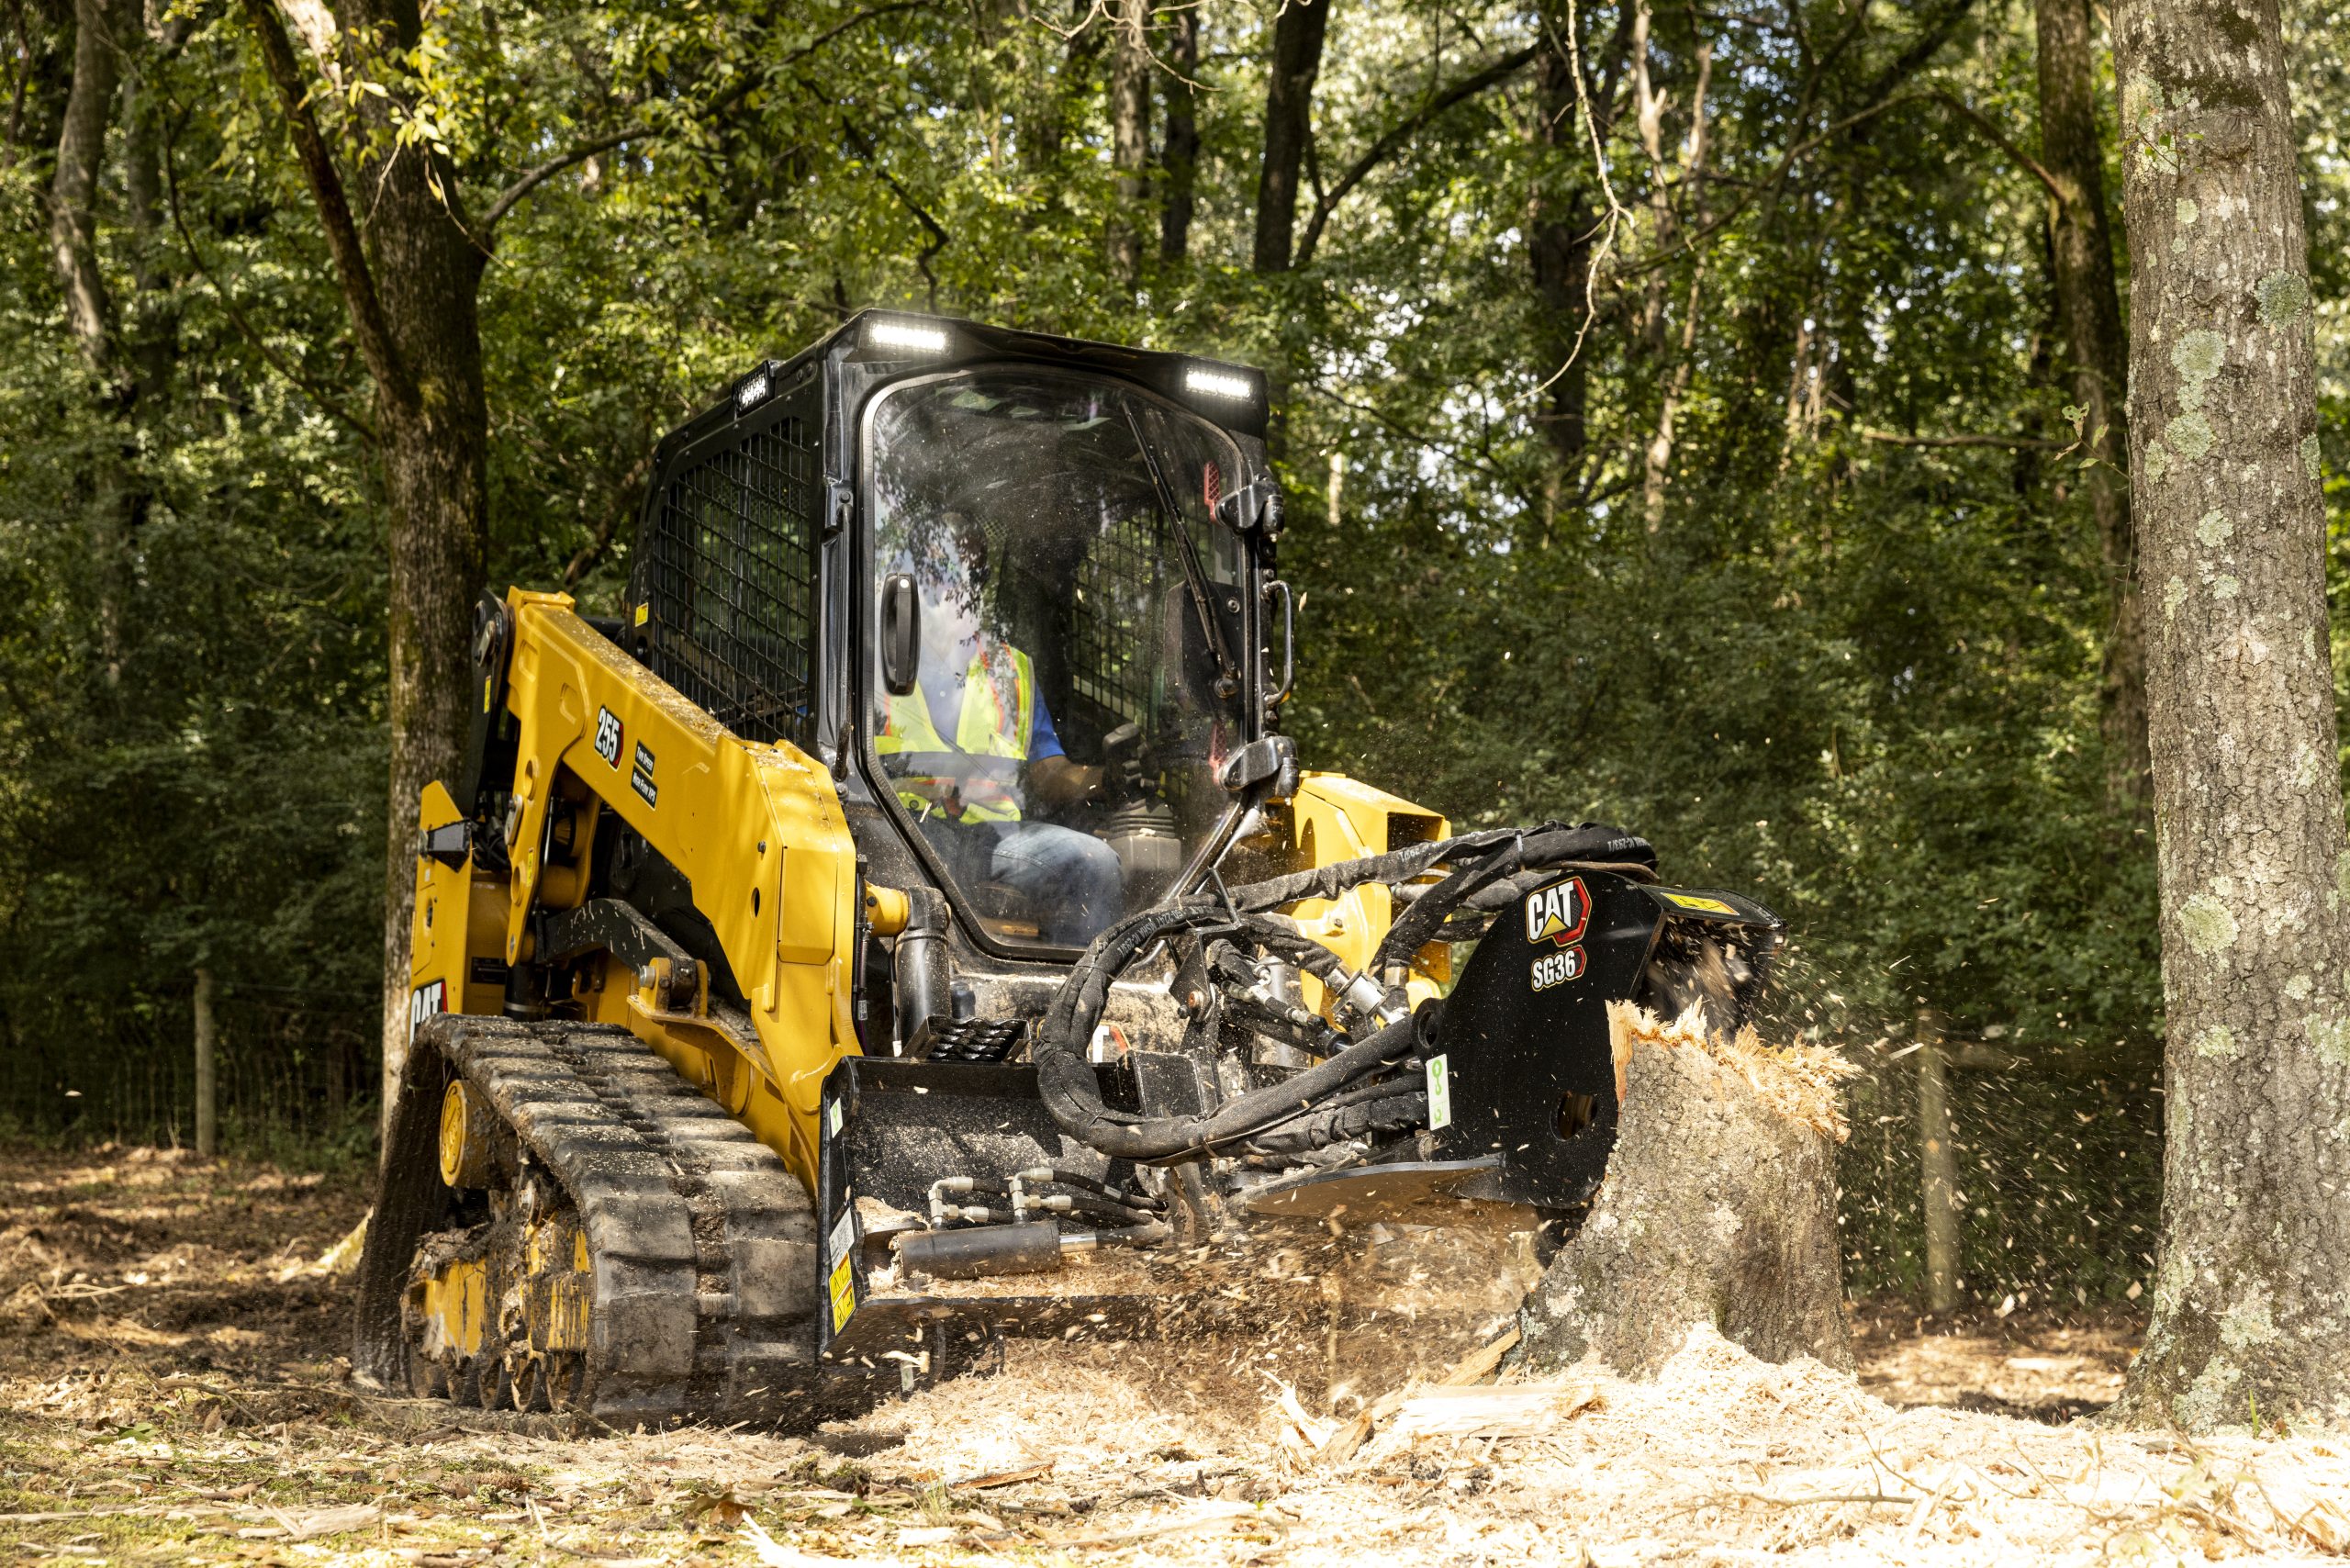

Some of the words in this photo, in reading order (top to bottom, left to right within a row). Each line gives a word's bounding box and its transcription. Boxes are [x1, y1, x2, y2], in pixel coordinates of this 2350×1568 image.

[595, 708, 620, 762] 255
[1528, 881, 1574, 941] CAT
[1533, 950, 1576, 989] SG36
